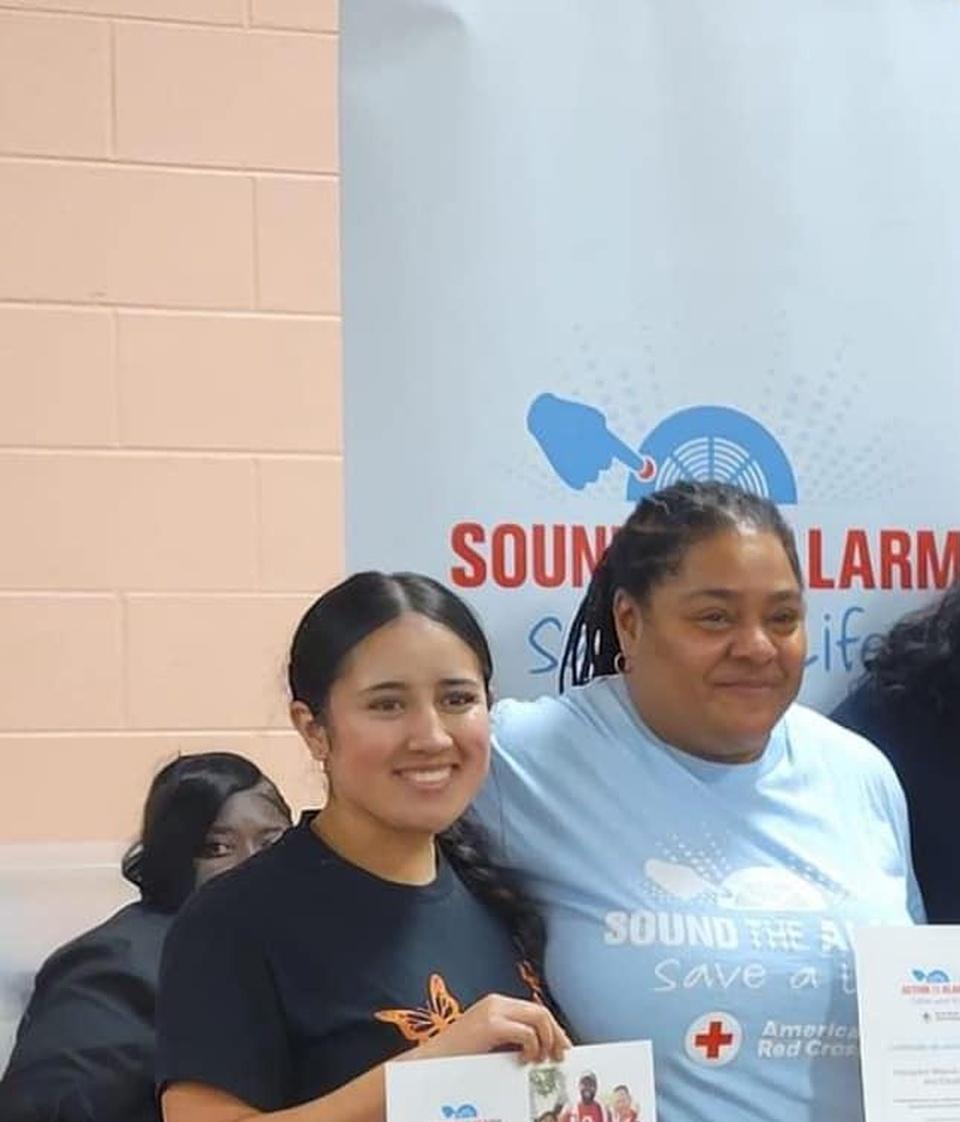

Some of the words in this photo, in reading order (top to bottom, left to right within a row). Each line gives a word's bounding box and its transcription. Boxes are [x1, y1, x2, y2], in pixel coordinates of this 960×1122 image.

[450, 522, 623, 588] SOUN
[604, 910, 739, 949] SOUND
[746, 919, 811, 952] THE
[653, 957, 767, 993] Save
[789, 965, 820, 991] a
[761, 1020, 860, 1038] America
[757, 1039, 801, 1058] Red
[805, 1040, 859, 1057] Cros
